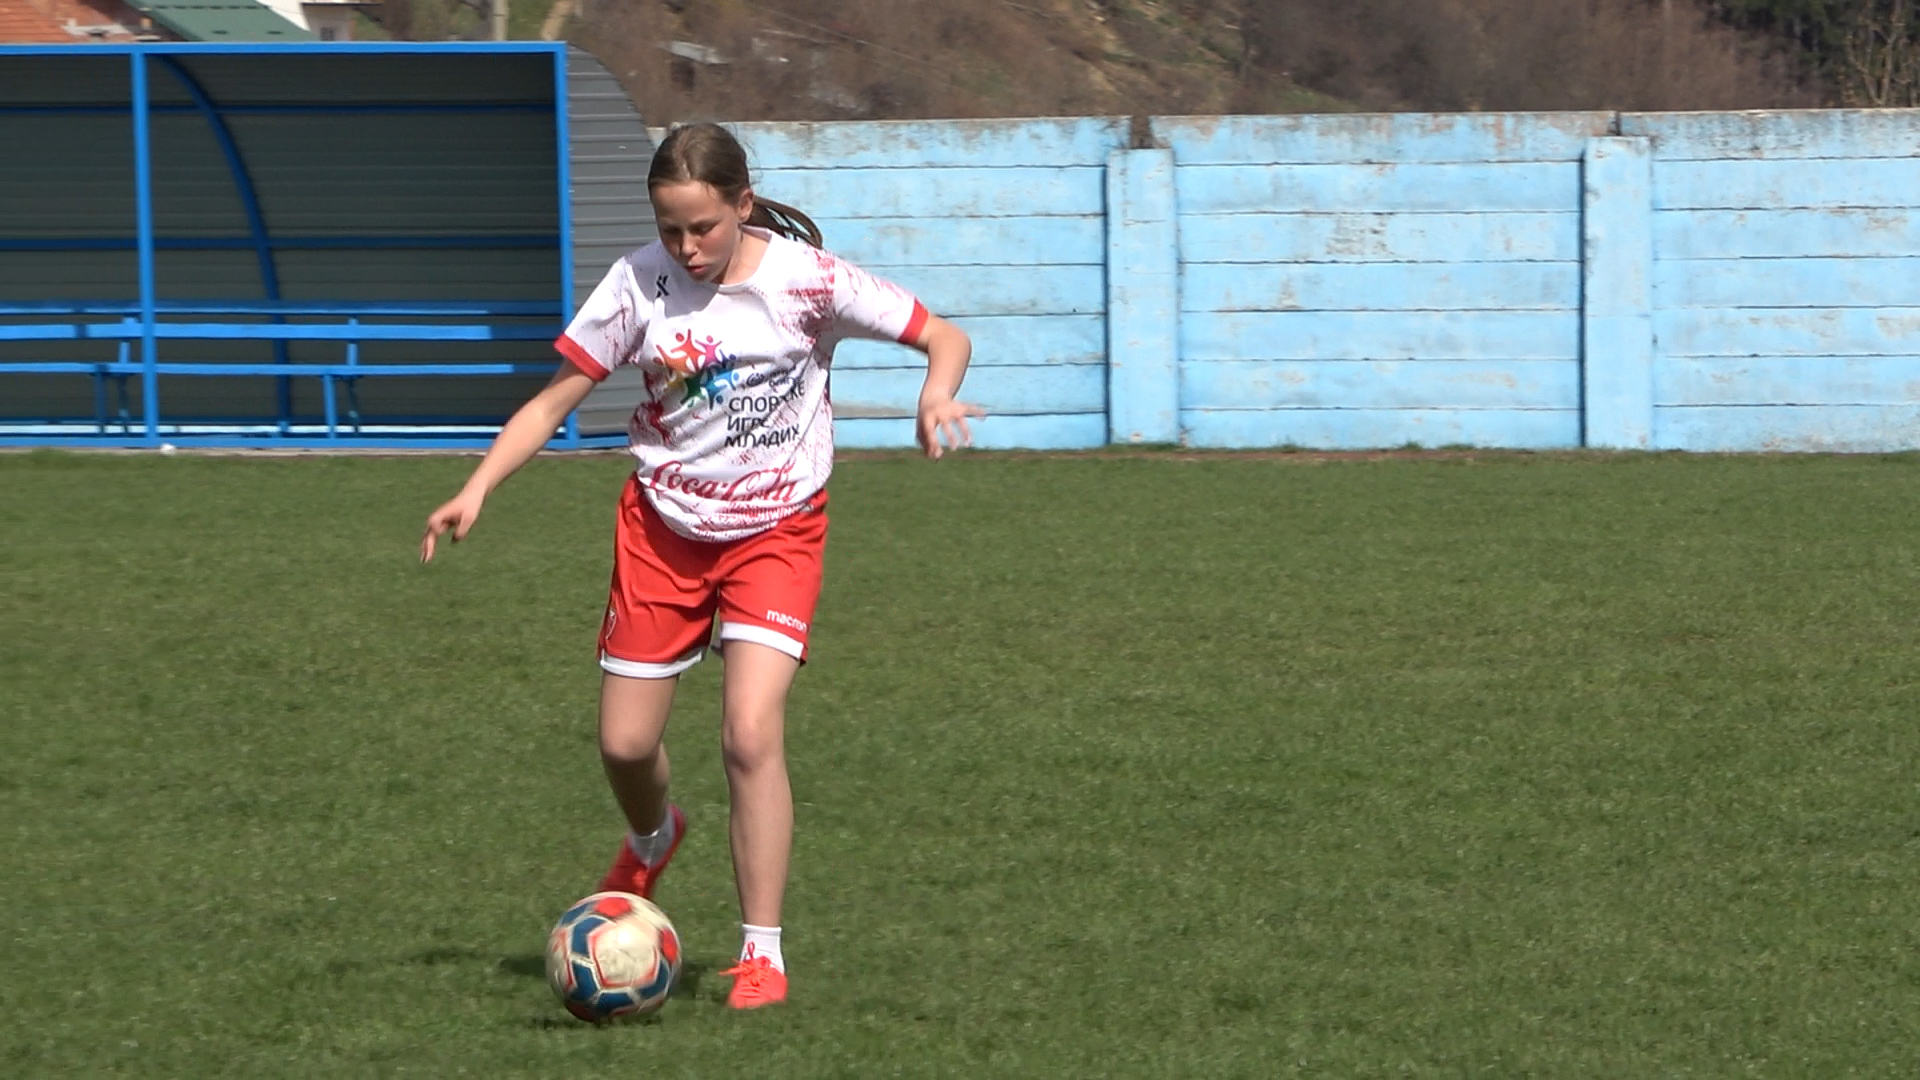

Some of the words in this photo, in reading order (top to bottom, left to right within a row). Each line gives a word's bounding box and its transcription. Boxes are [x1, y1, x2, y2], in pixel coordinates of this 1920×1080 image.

[728, 380, 805, 413] СПОРКЕ
[724, 423, 800, 449] МЛАДИХ
[766, 609, 808, 633] macron
